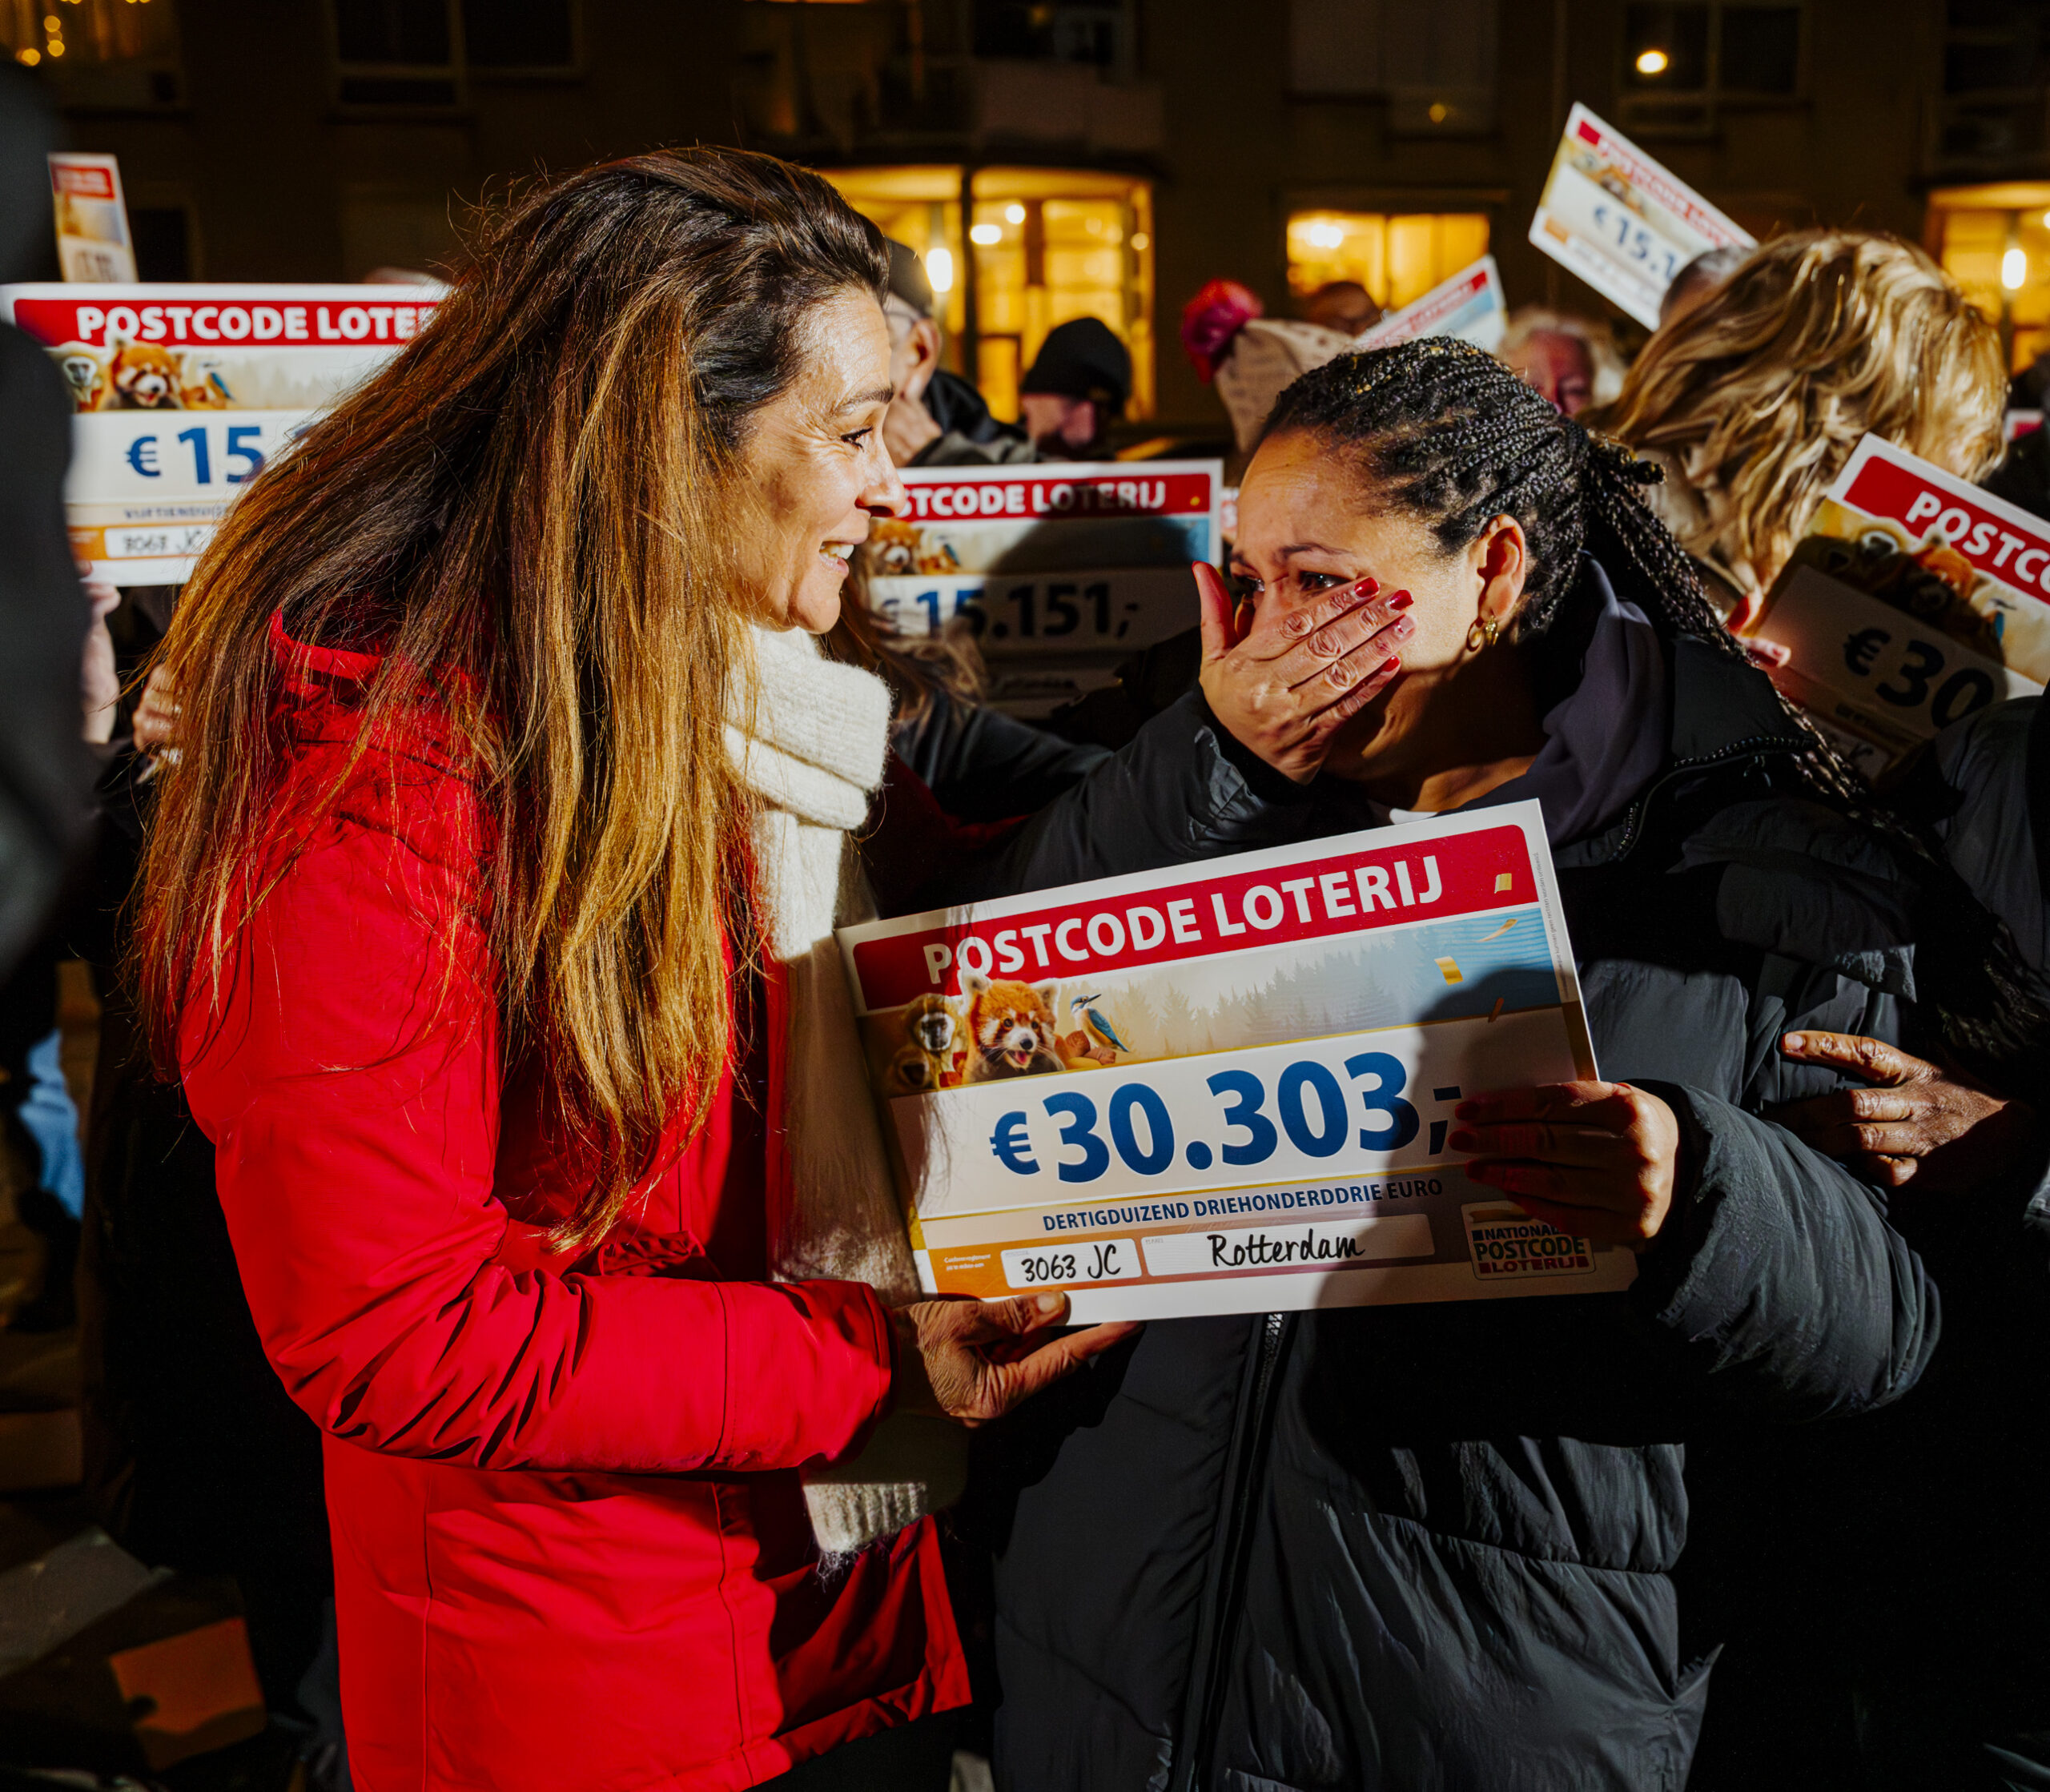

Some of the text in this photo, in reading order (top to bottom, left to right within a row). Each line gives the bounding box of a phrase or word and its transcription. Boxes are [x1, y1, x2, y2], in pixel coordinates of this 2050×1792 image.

[77, 306, 309, 341] POSTCODE
[125, 436, 162, 477] €
[1031, 480, 1167, 513] LOTERIJ
[1844, 629, 1891, 677] €
[922, 854, 1443, 985] POSTCODE LOTERIJ
[1043, 1178, 1442, 1231] DERTIGDUIZEND DRIEHONDERDDRIE EURO
[1021, 1254, 1076, 1282] 3063
[1087, 1244, 1121, 1279] JC
[1207, 1227, 1365, 1267] Rotterdam
[1473, 1236, 1586, 1261] POSTCODE
[1492, 1256, 1576, 1273] LOTERIJ
